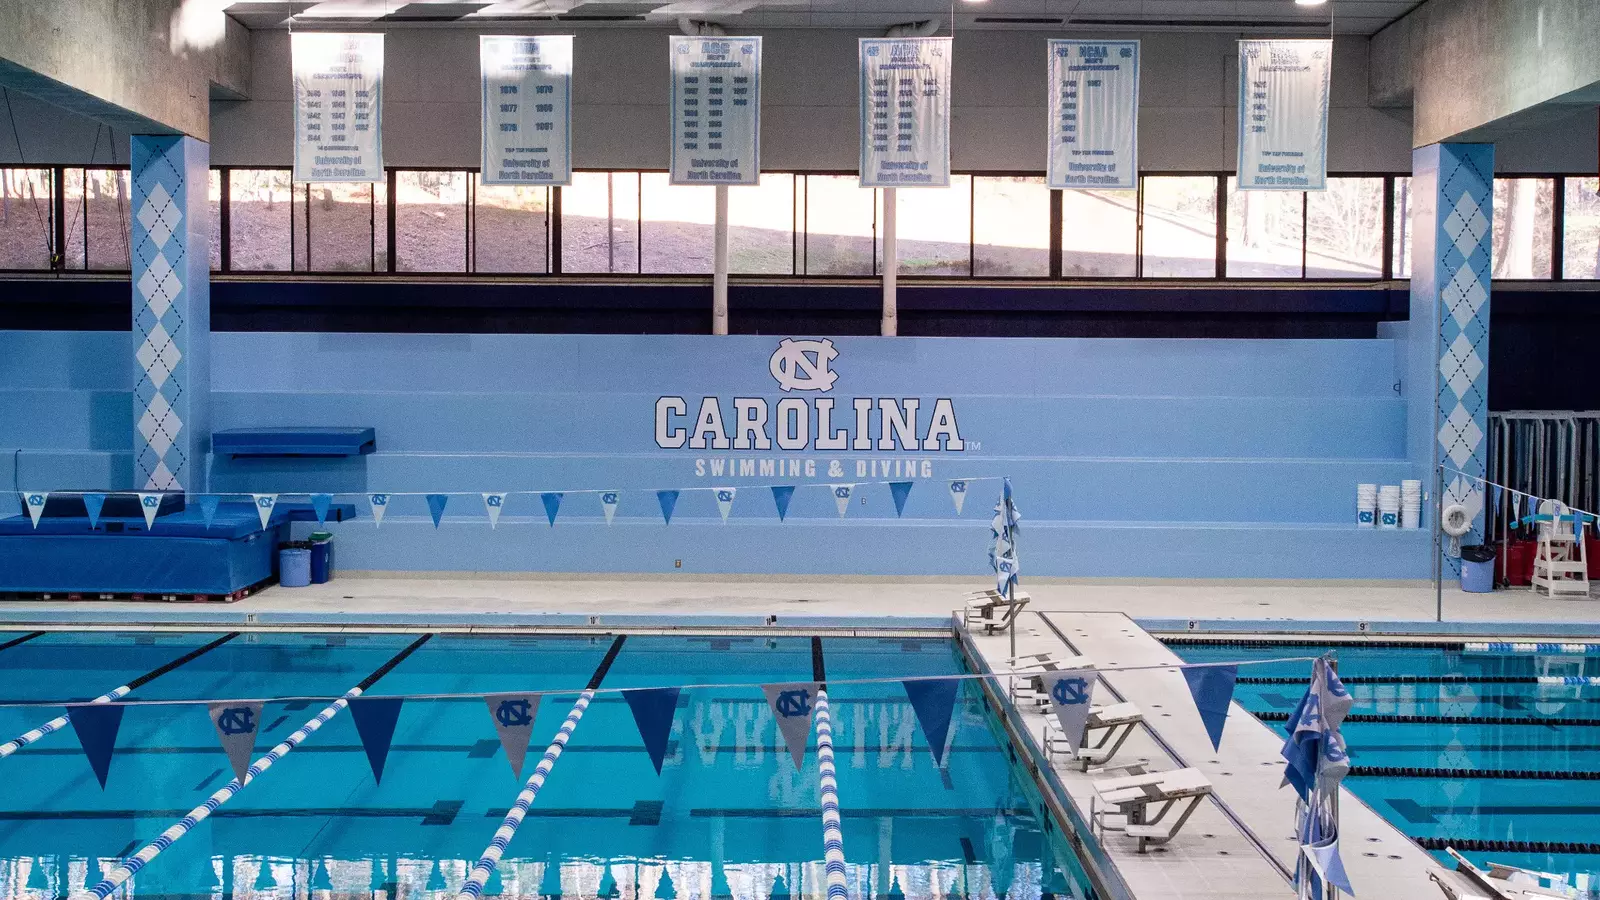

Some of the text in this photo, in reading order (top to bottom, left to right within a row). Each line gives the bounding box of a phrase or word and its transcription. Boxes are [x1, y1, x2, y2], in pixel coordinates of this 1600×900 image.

[701, 42, 730, 53] ACC
[1079, 46, 1108, 58] NCAA
[315, 155, 362, 165] University of
[503, 158, 550, 168] University of
[691, 158, 738, 168] University of
[881, 160, 928, 170] University of
[311, 167, 365, 177] North Carolina
[1068, 162, 1116, 172] University of
[1258, 163, 1305, 173] University of
[499, 170, 553, 179] North Carolina
[687, 170, 742, 179] North Carolina
[877, 172, 931, 181] North Carolina
[1065, 174, 1119, 183] North Carolina
[1254, 175, 1308, 185] North Carolina
[654, 396, 981, 451] CAROLINA TM
[695, 458, 932, 478] SWIMMING & DIVING
